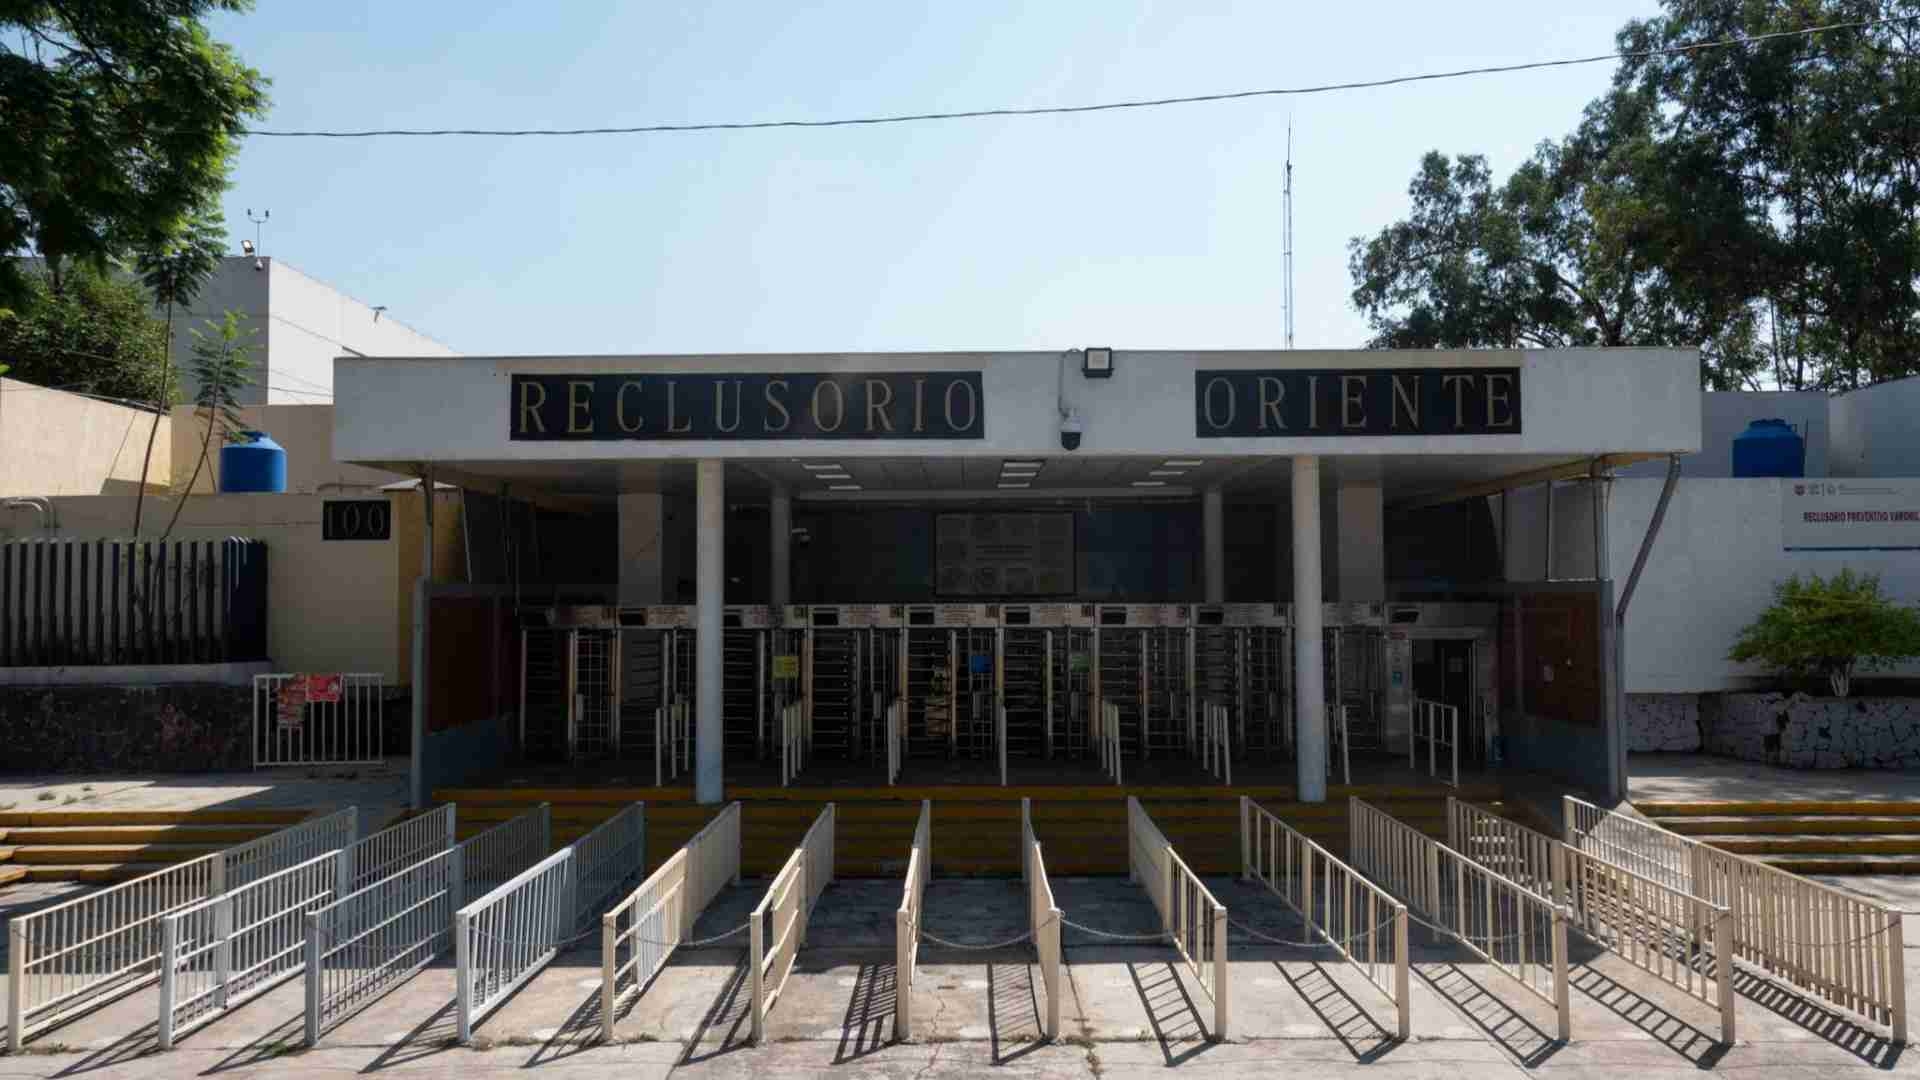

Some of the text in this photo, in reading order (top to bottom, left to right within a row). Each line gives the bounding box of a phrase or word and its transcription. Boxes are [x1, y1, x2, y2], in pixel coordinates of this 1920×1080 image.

[518, 373, 1514, 434] RECLUSORIO ORIENTE
[326, 503, 385, 537] 100
[1803, 511, 1845, 522] RECLUSORIO
[1846, 511, 1888, 522] PREVENTIVO
